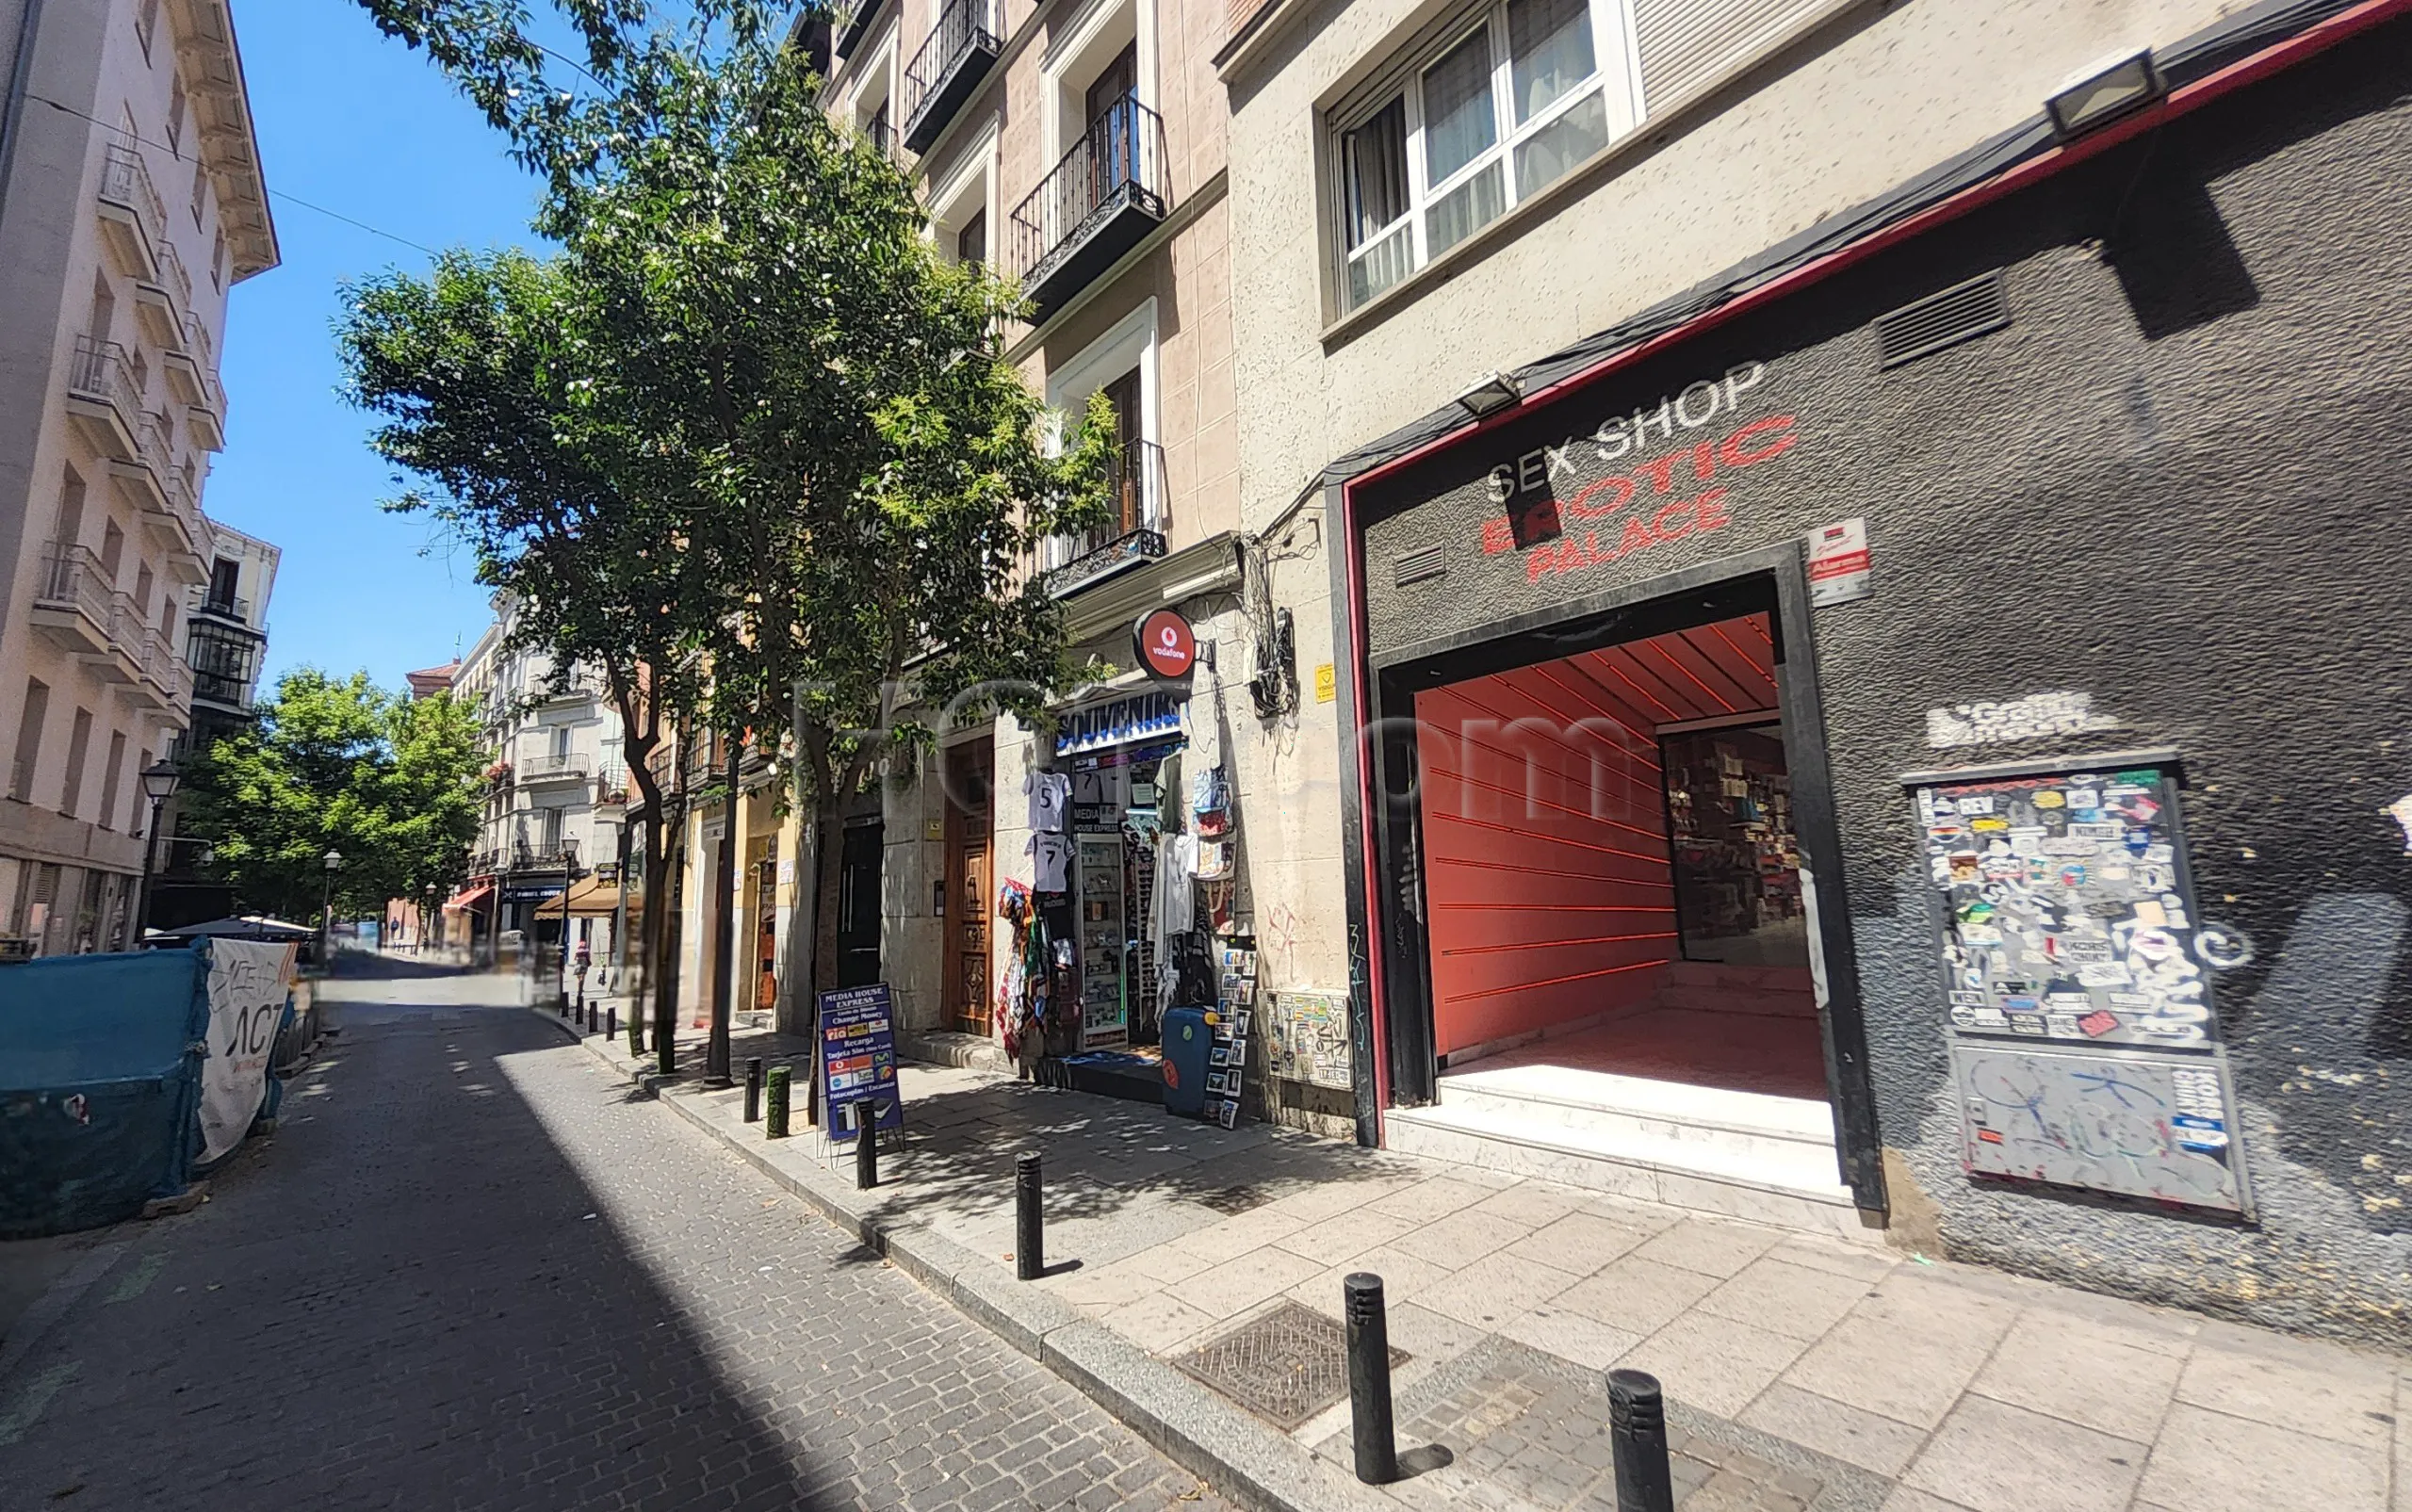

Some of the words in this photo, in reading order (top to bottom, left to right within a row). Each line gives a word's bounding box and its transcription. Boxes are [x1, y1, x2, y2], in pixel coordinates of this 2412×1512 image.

[1488, 436, 1576, 502] SEX
[1596, 360, 1766, 460] SHOP
[1480, 415, 1799, 554] EROTIC
[1525, 486, 1731, 583] PALACE
[1152, 647, 1185, 659] vodafone
[1040, 788, 1051, 808] 5
[1074, 808, 1099, 820] MEDIA
[1074, 824, 1093, 833] HOUSE
[1046, 850, 1055, 870] 7
[825, 992, 853, 1002] MEDIA
[855, 987, 883, 998] HOUSE
[837, 997, 873, 1008] EXPRESS
[832, 1016, 859, 1024] Change
[844, 1037, 874, 1048] Recarga
[827, 1049, 851, 1059] Tarjeta
[830, 1088, 864, 1100] Fotocopias
